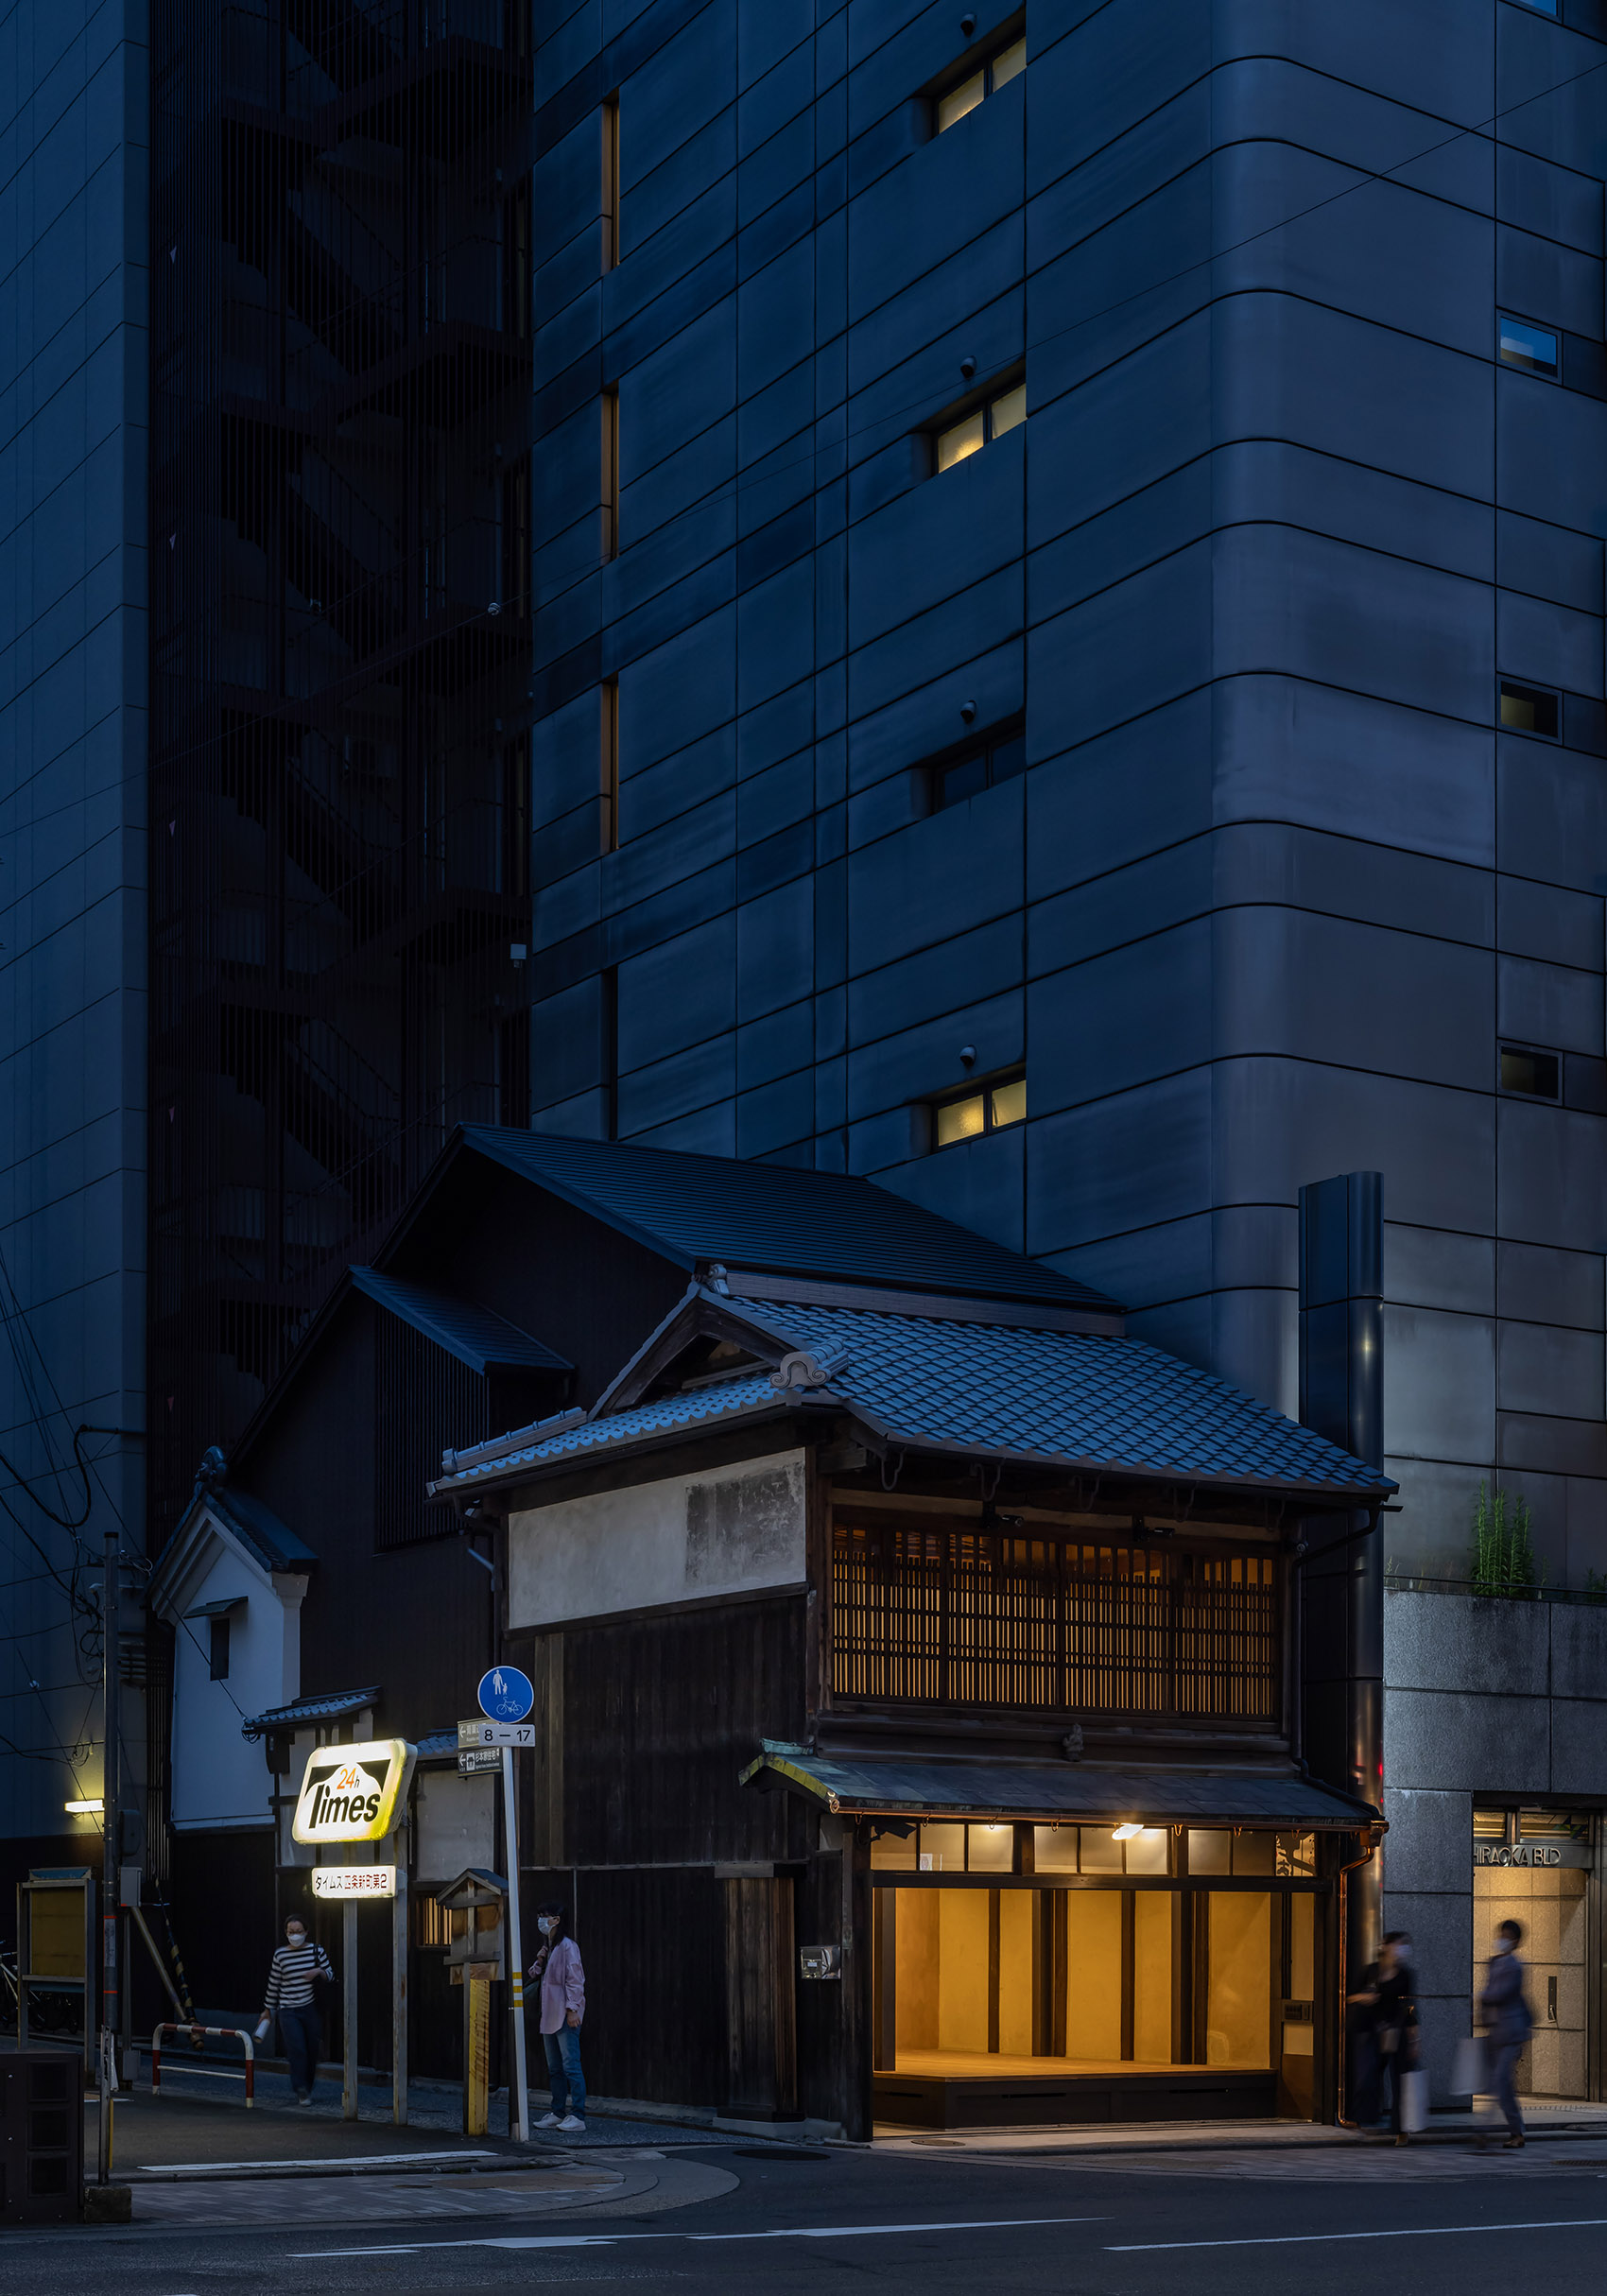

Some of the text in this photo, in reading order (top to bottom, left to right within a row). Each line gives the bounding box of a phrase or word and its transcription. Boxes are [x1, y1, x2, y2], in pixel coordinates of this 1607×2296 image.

[484, 1729, 493, 1741] 8
[516, 1729, 531, 1742] 17
[337, 1767, 360, 1789] 24h
[308, 1783, 381, 1829] Times
[1533, 1847, 1561, 1866] BLD
